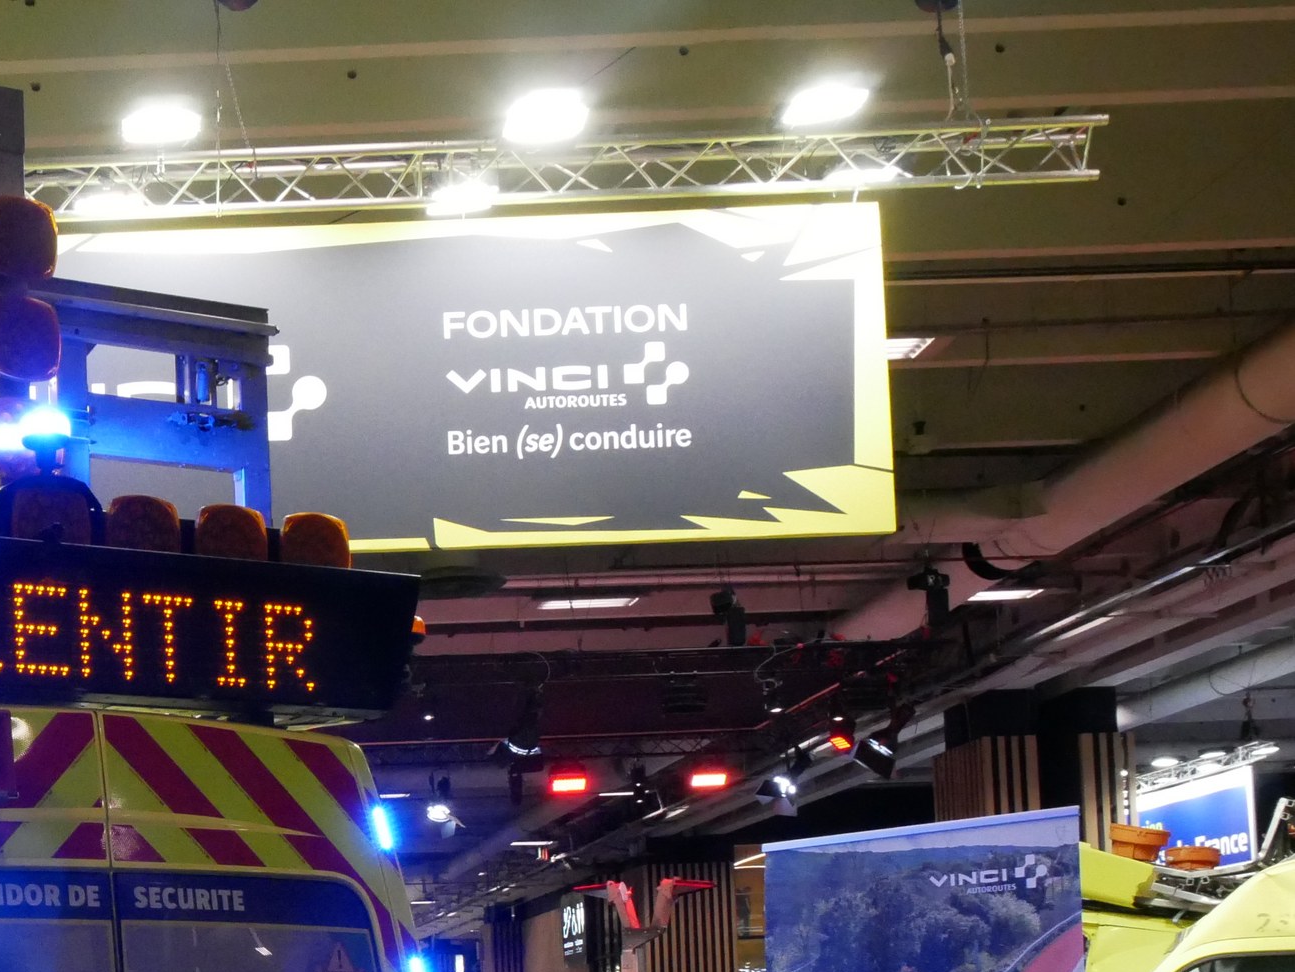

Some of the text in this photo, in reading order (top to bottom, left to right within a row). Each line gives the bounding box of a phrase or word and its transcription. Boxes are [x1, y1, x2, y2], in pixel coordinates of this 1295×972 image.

[443, 303, 688, 339] FONDATION
[445, 364, 609, 394] VINCI
[524, 393, 627, 410] AUTOROUTES
[447, 422, 692, 460] Bien (se) conduire
[929, 868, 1007, 888] VINCI
[966, 883, 1017, 895] AUTOROUTES
[68, 884, 100, 908] DE
[133, 885, 245, 912] SECURITE
